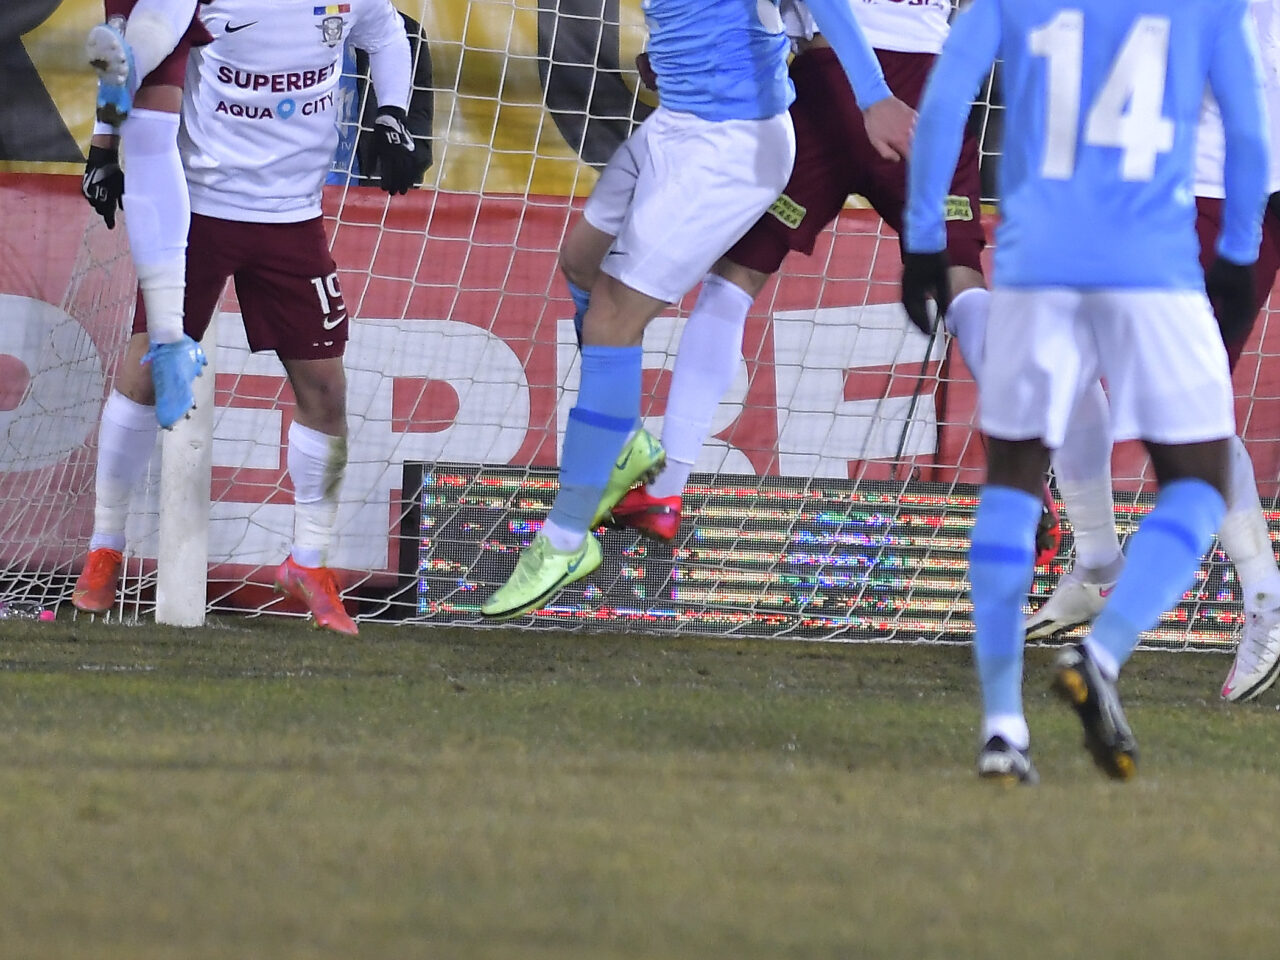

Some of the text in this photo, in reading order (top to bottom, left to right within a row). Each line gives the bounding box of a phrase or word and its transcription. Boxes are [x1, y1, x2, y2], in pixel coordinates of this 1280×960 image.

[217, 58, 338, 93] SUPERBET
[1028, 7, 1174, 182] 14
[215, 91, 334, 120] AQUA CITY
[310, 272, 346, 315] 19
